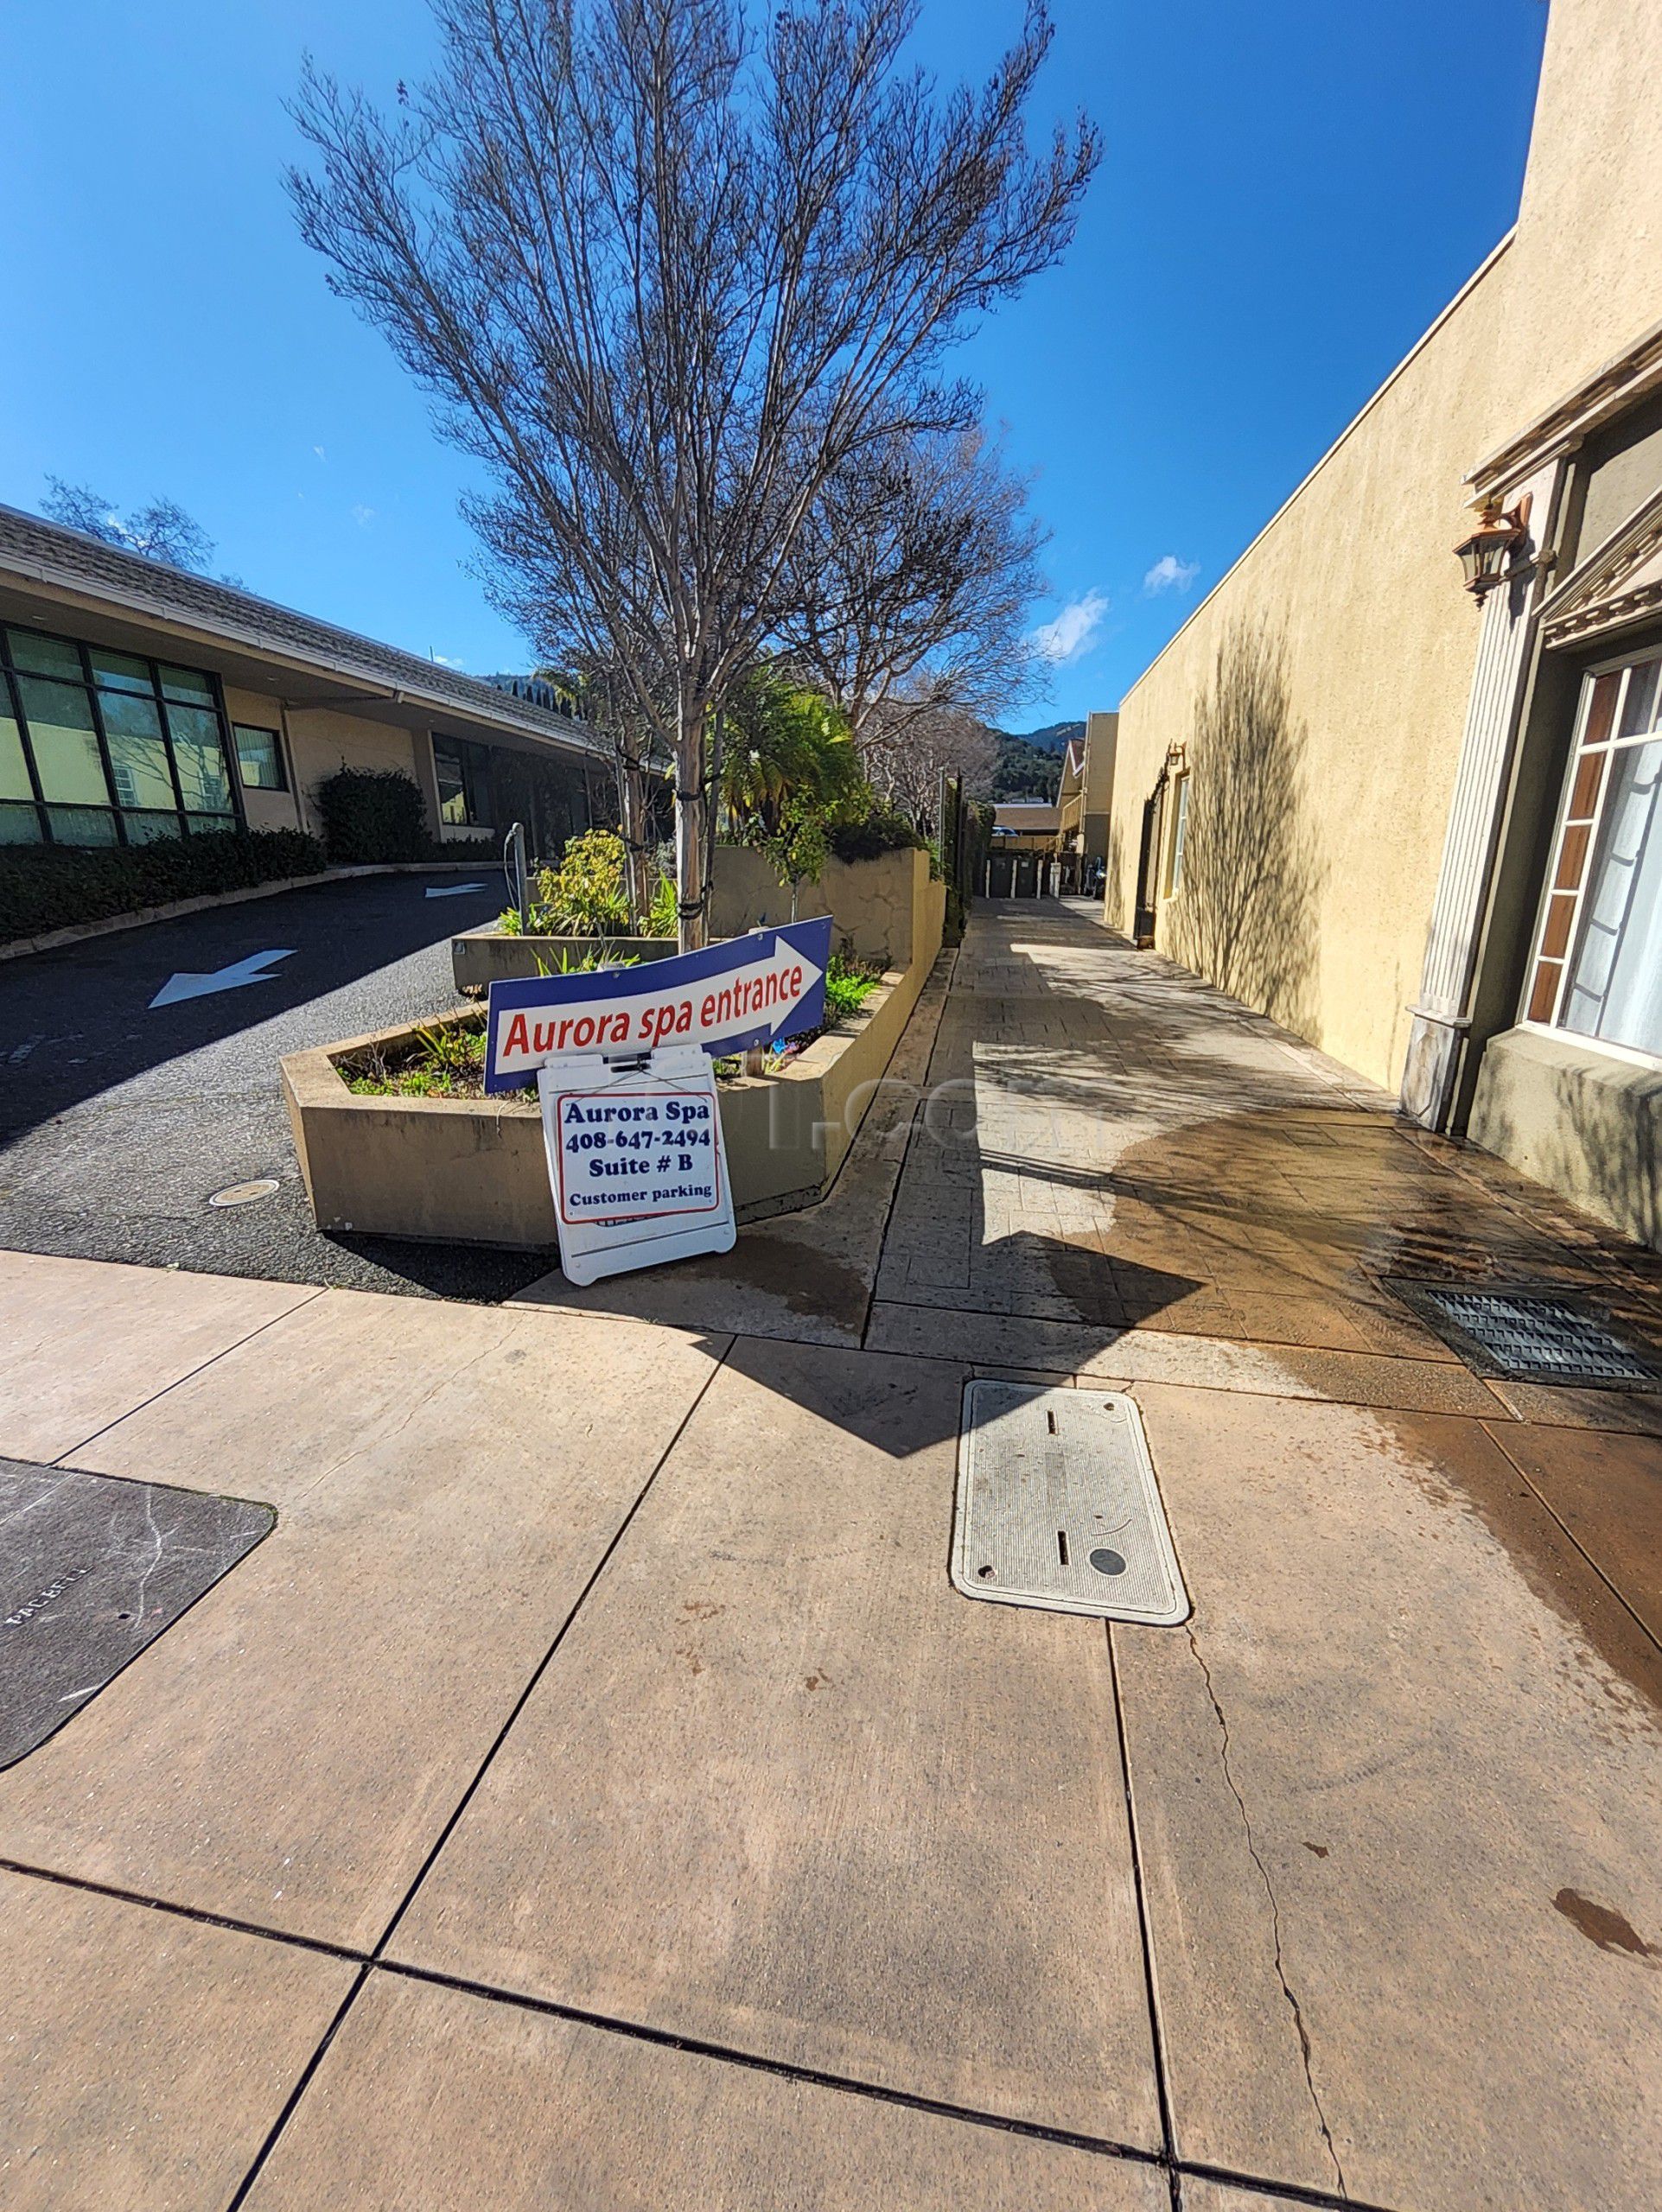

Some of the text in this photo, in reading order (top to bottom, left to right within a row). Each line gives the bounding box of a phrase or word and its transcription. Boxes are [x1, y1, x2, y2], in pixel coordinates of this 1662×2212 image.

[502, 964, 803, 1058] Aurora spa entrance
[564, 1101, 710, 1124] Aurora Spa
[565, 1128, 711, 1154] 408-647-2494
[589, 1154, 693, 1177] Suite # B
[569, 1184, 713, 1207] Customer parking
